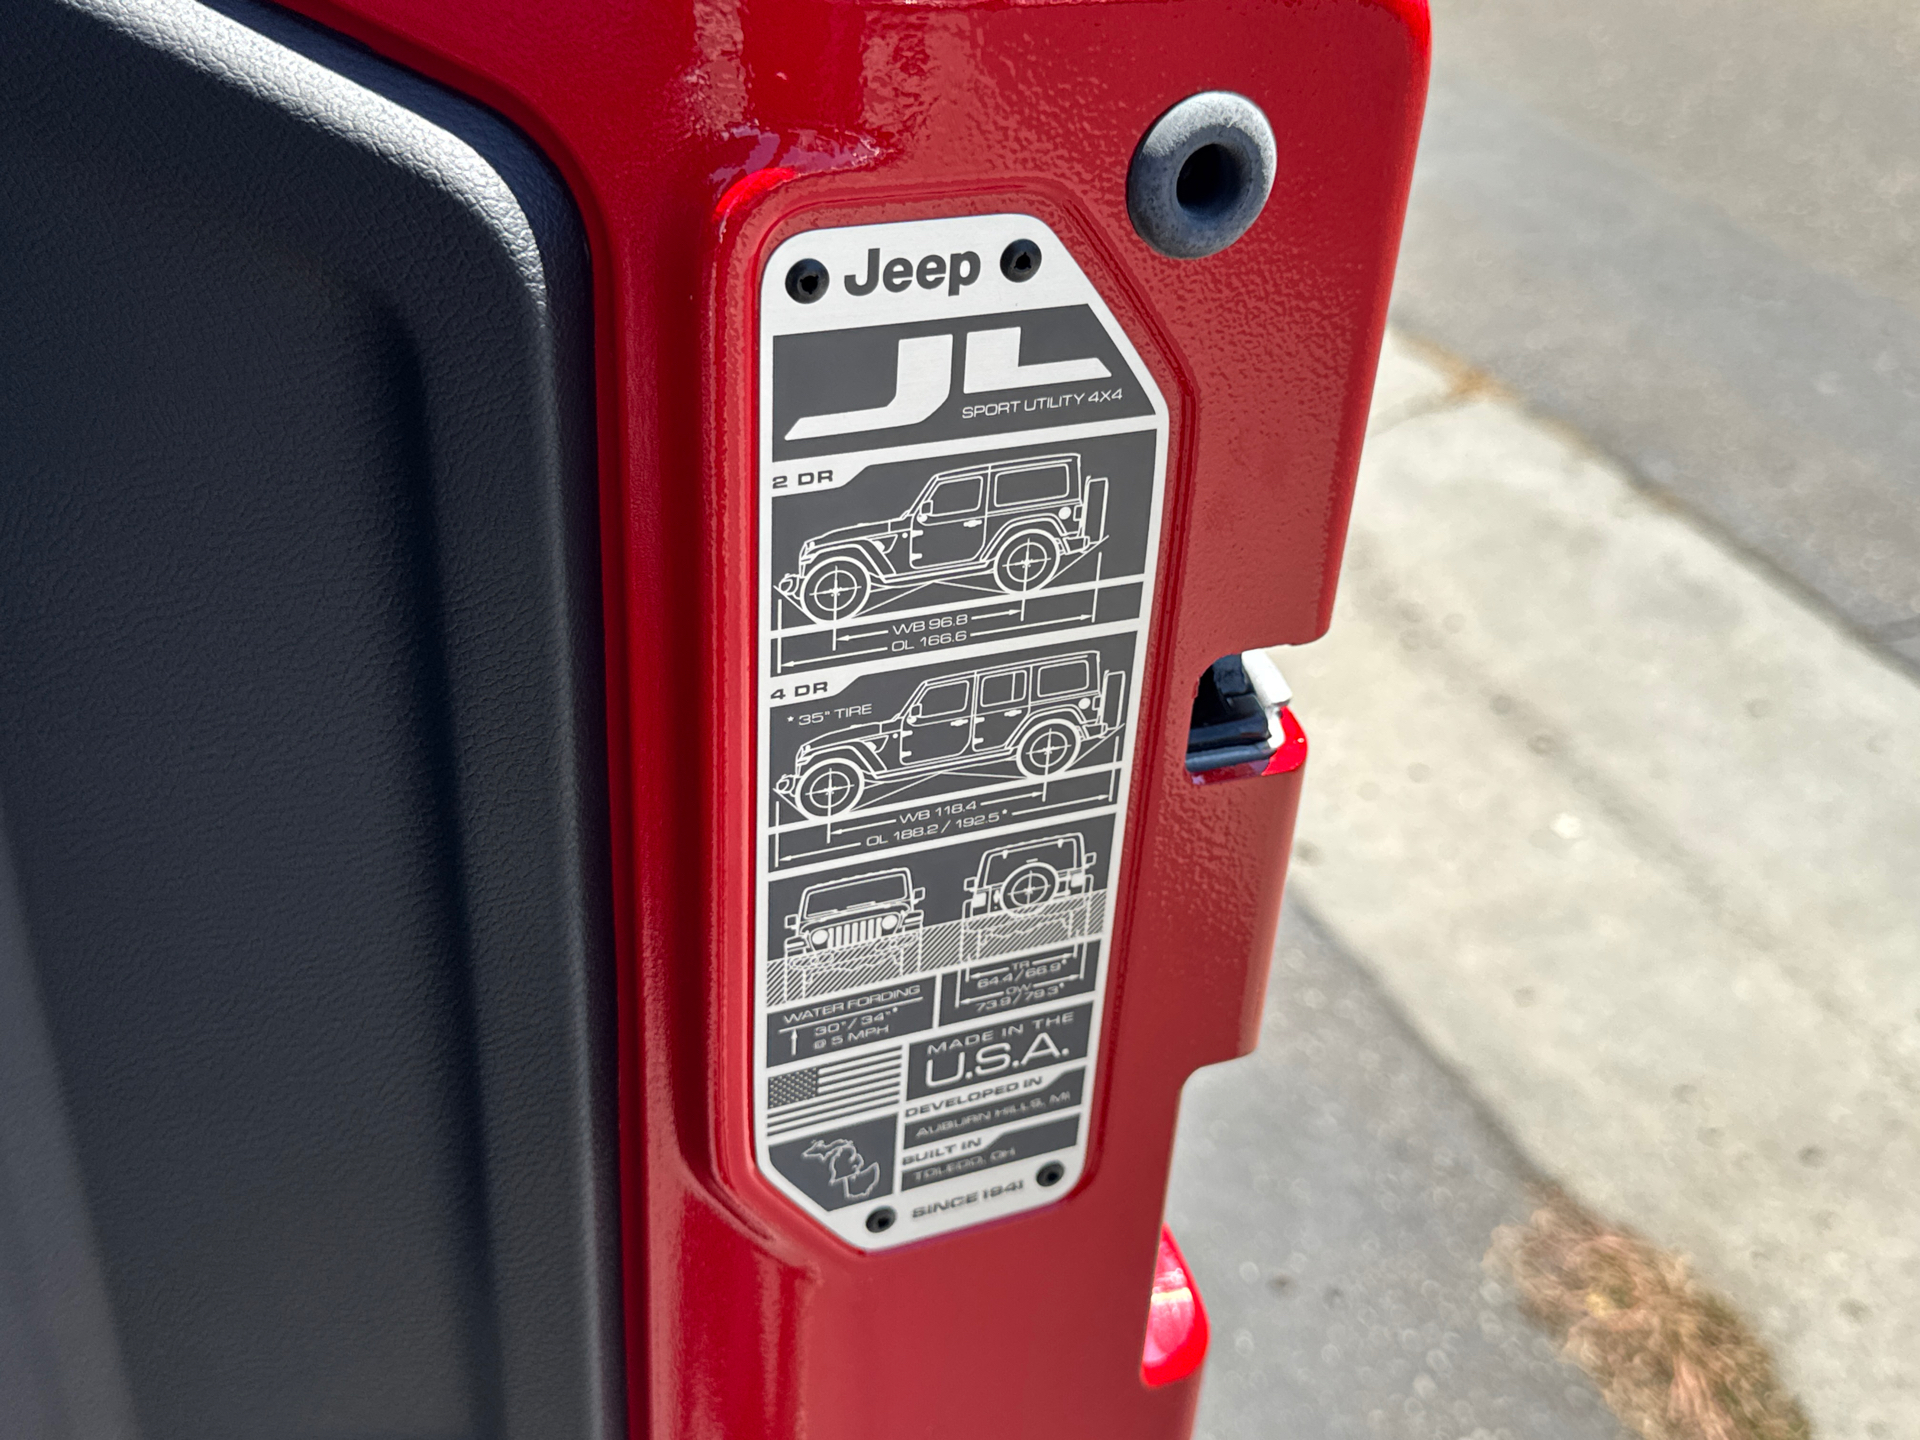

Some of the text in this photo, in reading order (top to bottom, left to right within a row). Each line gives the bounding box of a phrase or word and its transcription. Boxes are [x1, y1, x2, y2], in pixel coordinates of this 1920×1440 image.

[844, 248, 981, 297] Jeep
[785, 327, 1112, 441] JL
[962, 388, 1123, 419] SPORT UTILITY 4X4
[772, 470, 834, 489] 2 DR
[892, 614, 968, 636] WB 96.8
[891, 631, 968, 652] OL 166.6
[770, 681, 828, 700] 4 DR
[834, 704, 873, 719] TIRE
[899, 800, 977, 825] WB 118.4
[866, 835, 888, 847] OL
[893, 824, 939, 842] 188.2
[1012, 960, 1030, 971] TR
[1006, 983, 1032, 996] OW
[784, 984, 921, 1024] WATER FORDING
[831, 1035, 844, 1046] 5
[847, 1024, 889, 1042] MPH
[927, 1011, 1075, 1055] MADE IN THE
[925, 1032, 1070, 1088] U.S.A.
[905, 1076, 1043, 1118] DEVELOPED IN
[916, 1109, 992, 1138] AUBURN
[902, 1137, 982, 1166] BUILT IN
[912, 1191, 979, 1219] SINCE
